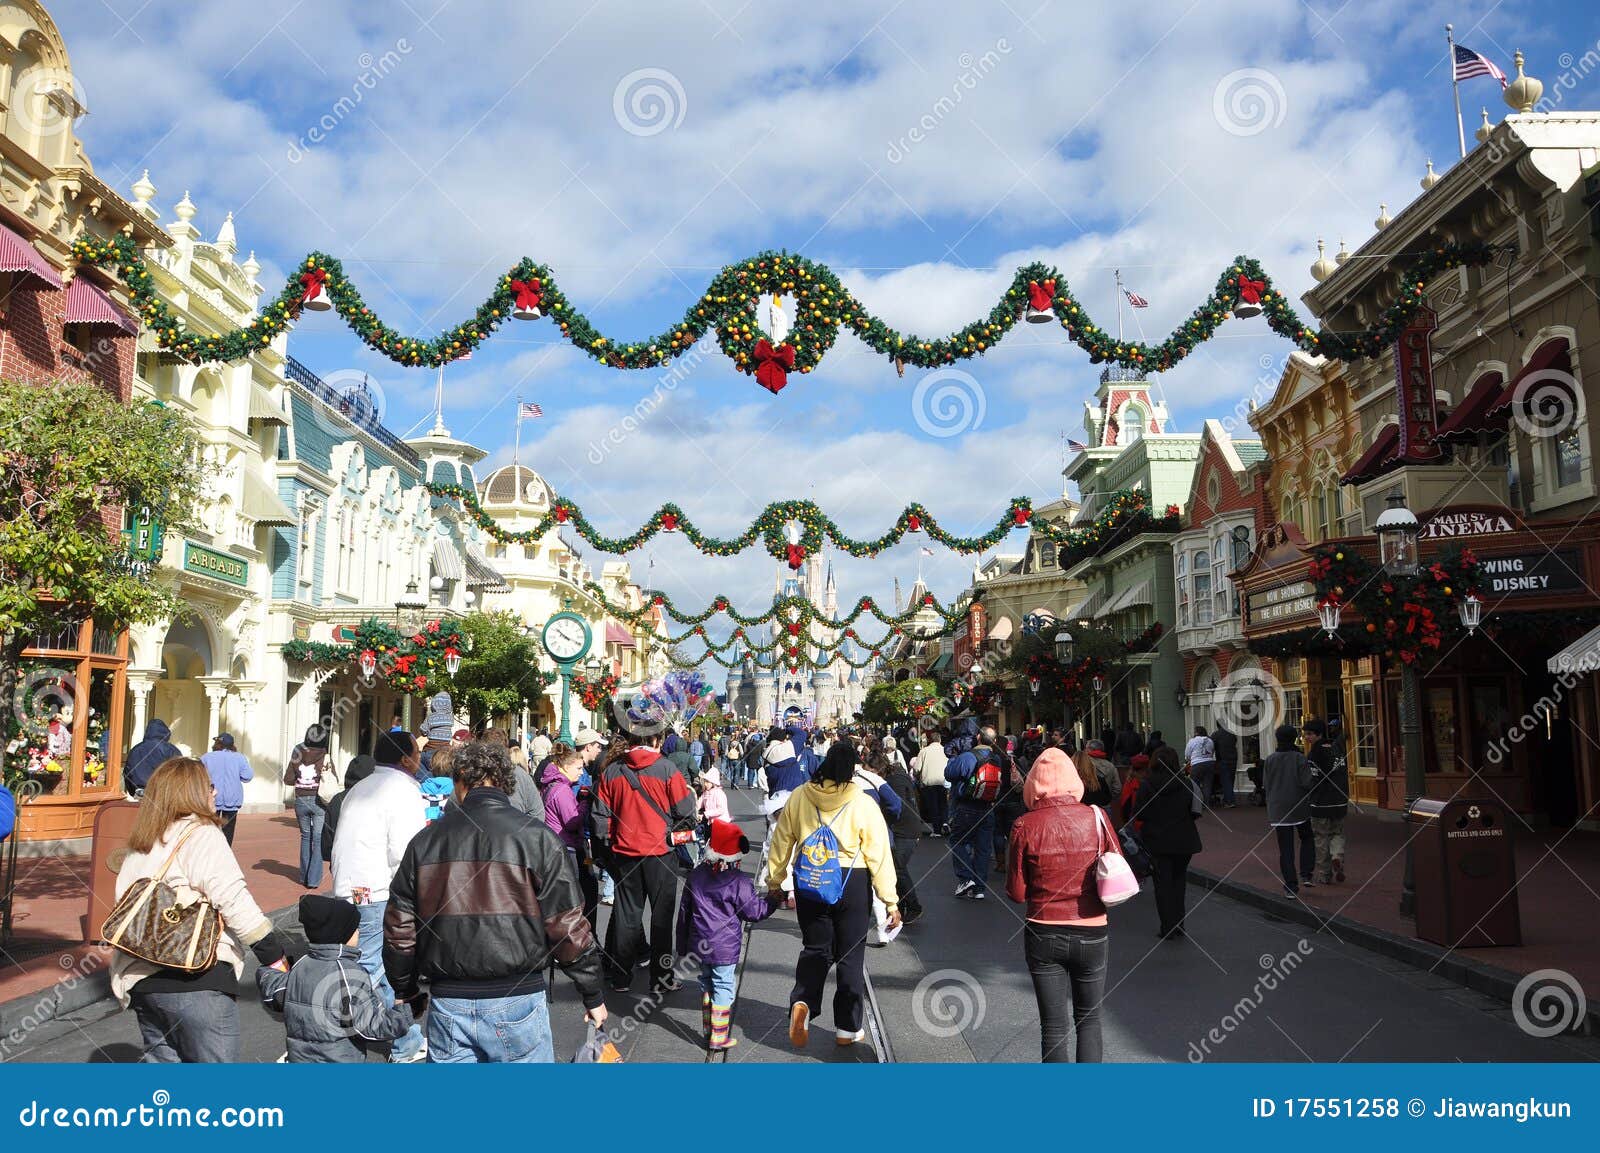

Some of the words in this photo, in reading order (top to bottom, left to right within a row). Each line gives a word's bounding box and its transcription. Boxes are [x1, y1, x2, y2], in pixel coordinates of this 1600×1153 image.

[1418, 516, 1513, 539] INEMA
[1434, 514, 1468, 525] MAIN
[188, 550, 242, 578] ARCADE
[1493, 575, 1549, 592] DISNEY
